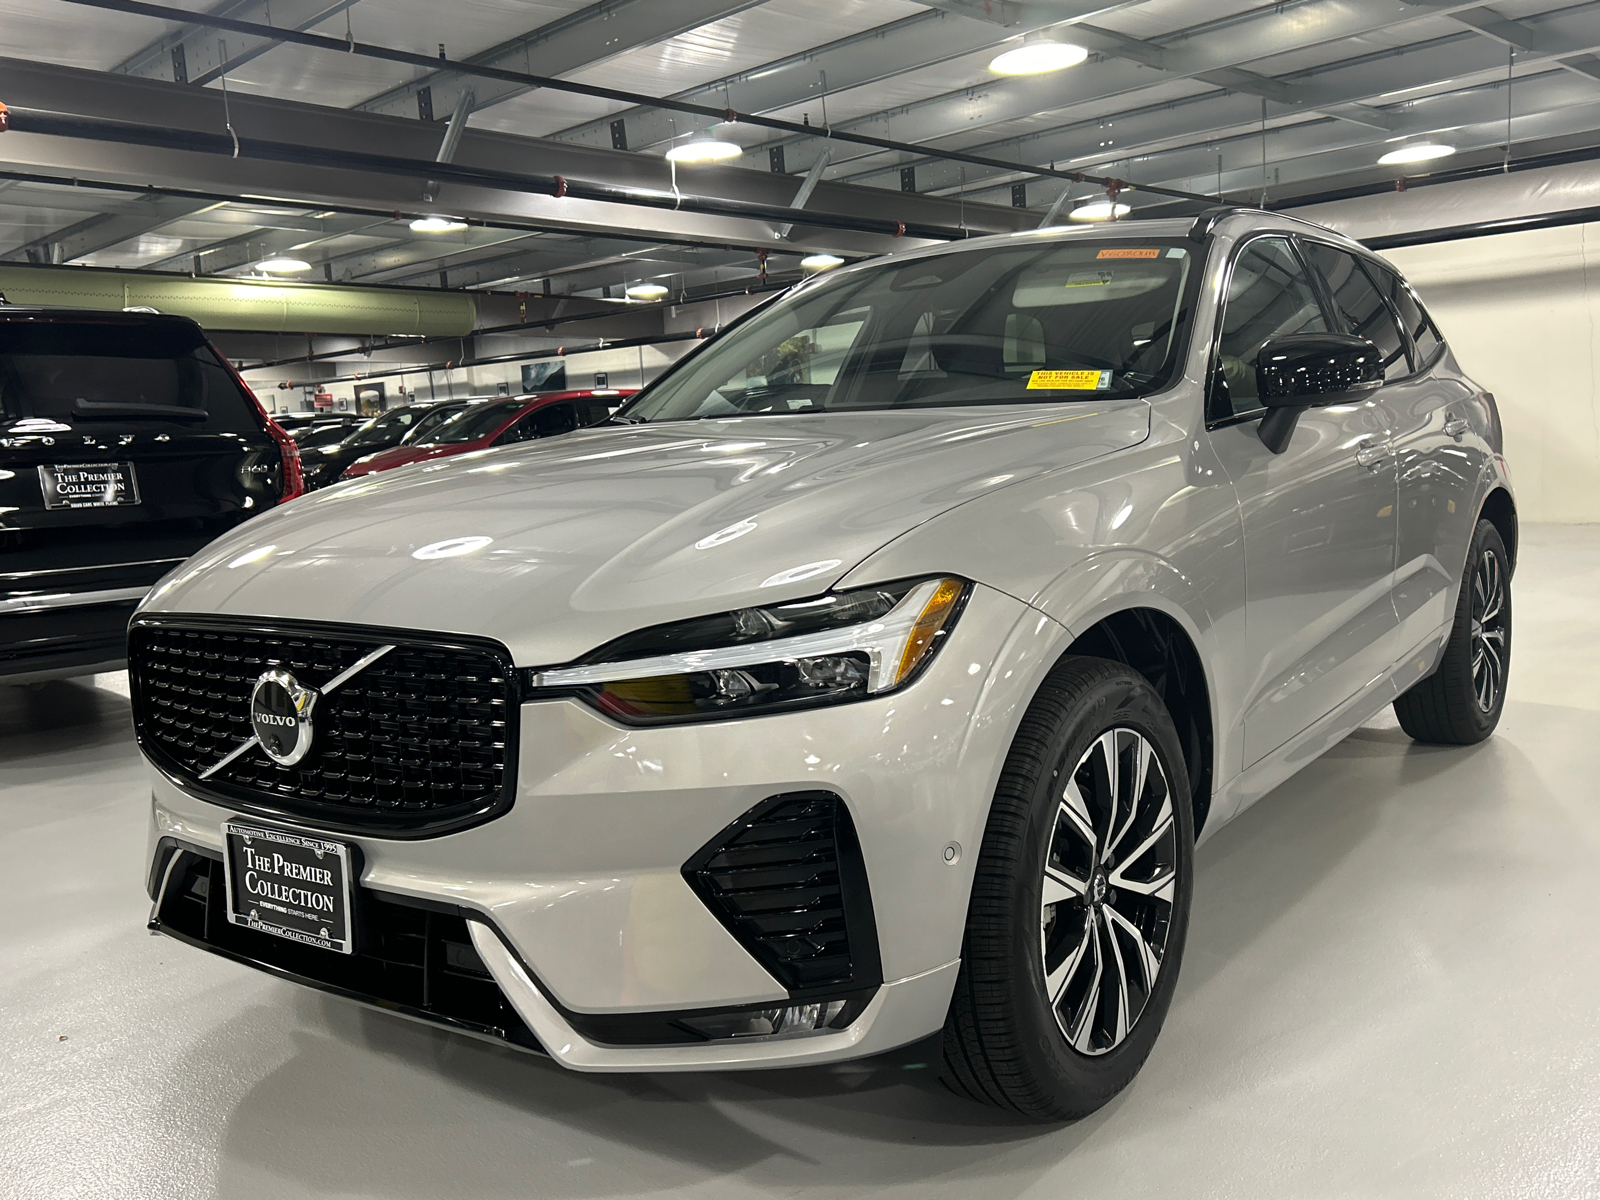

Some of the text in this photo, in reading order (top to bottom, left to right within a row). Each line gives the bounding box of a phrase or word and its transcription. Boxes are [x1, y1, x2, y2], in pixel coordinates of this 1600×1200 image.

[54, 471, 124, 483] THE PREMIER
[56, 482, 125, 494] COLLECTION
[254, 712, 296, 727] VOLVO
[229, 825, 337, 853] AUTOMOTIVE EXCELLENCE SINCE 1995
[243, 846, 333, 886] THE PREMIER
[245, 870, 334, 912] COLLECTION
[259, 900, 287, 914] EVERYTHING
[287, 908, 305, 919] STARTS
